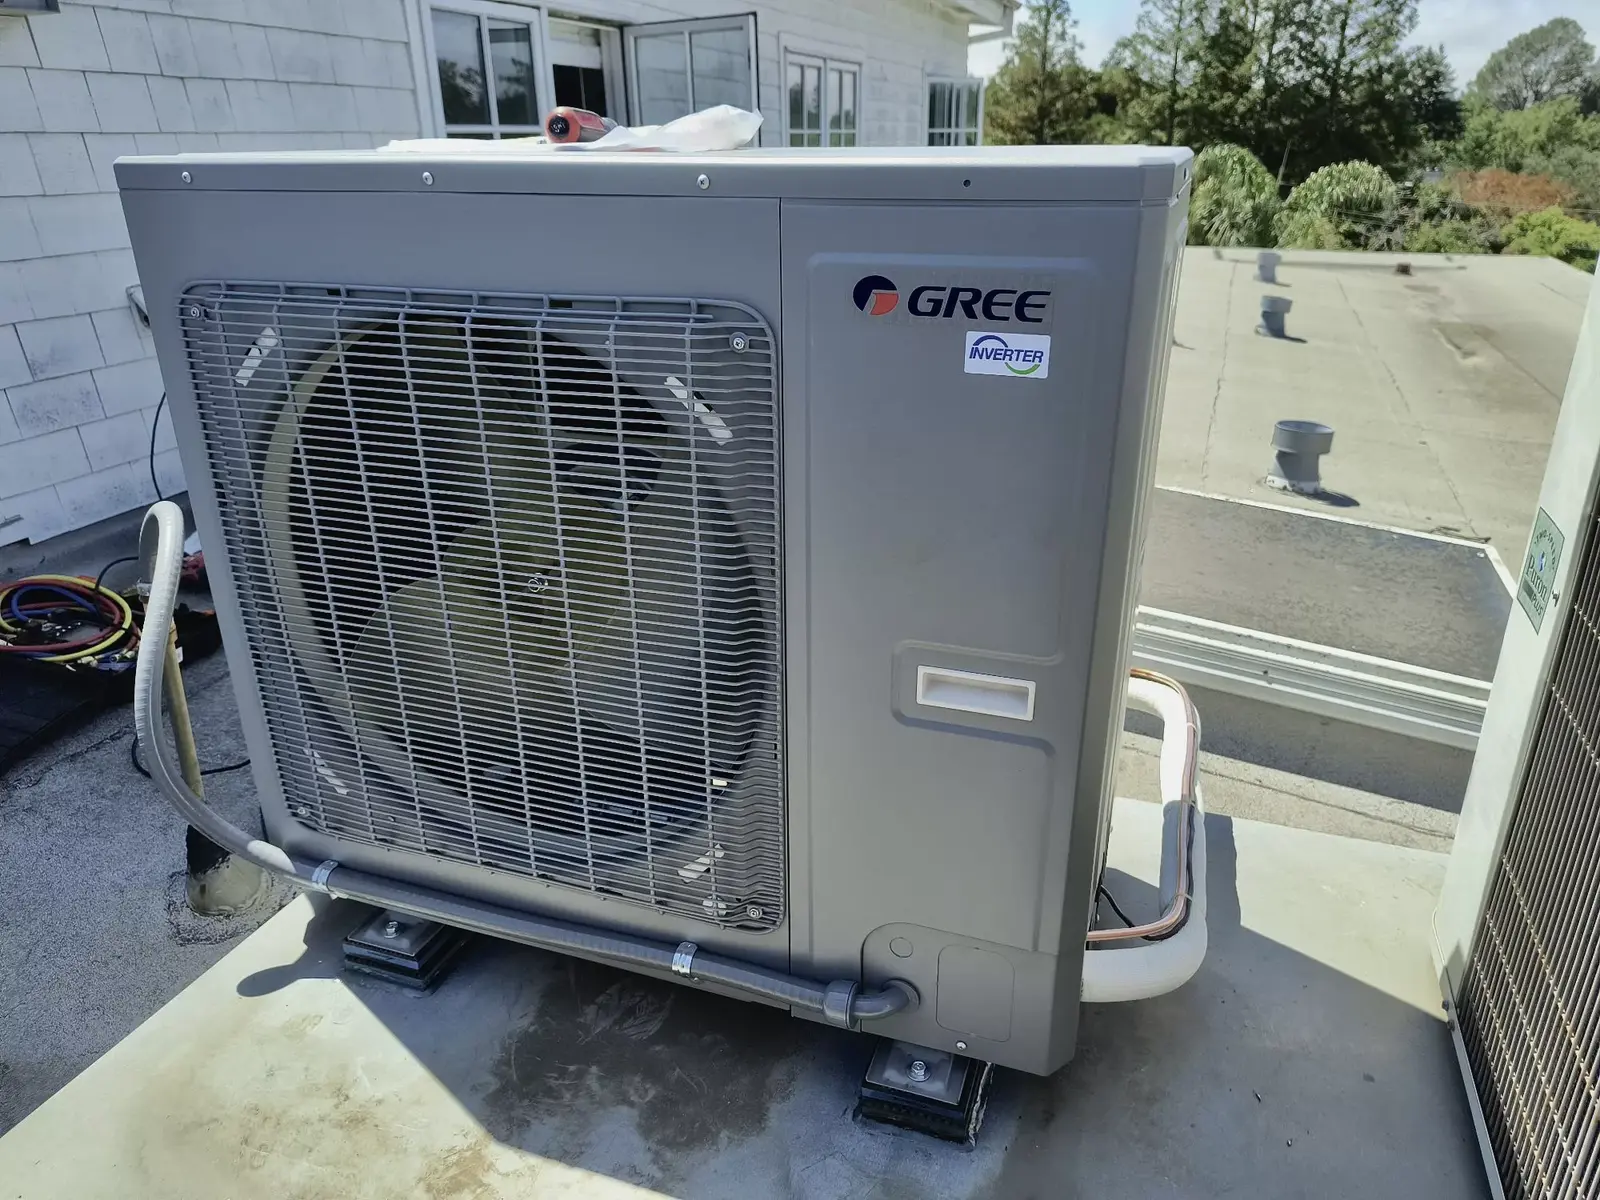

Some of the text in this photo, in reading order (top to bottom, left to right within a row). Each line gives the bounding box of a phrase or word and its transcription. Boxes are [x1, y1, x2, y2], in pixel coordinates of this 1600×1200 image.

[907, 285, 1051, 323] GREE
[969, 346, 1044, 363] INVERTER
[1526, 555, 1548, 602] Puron
